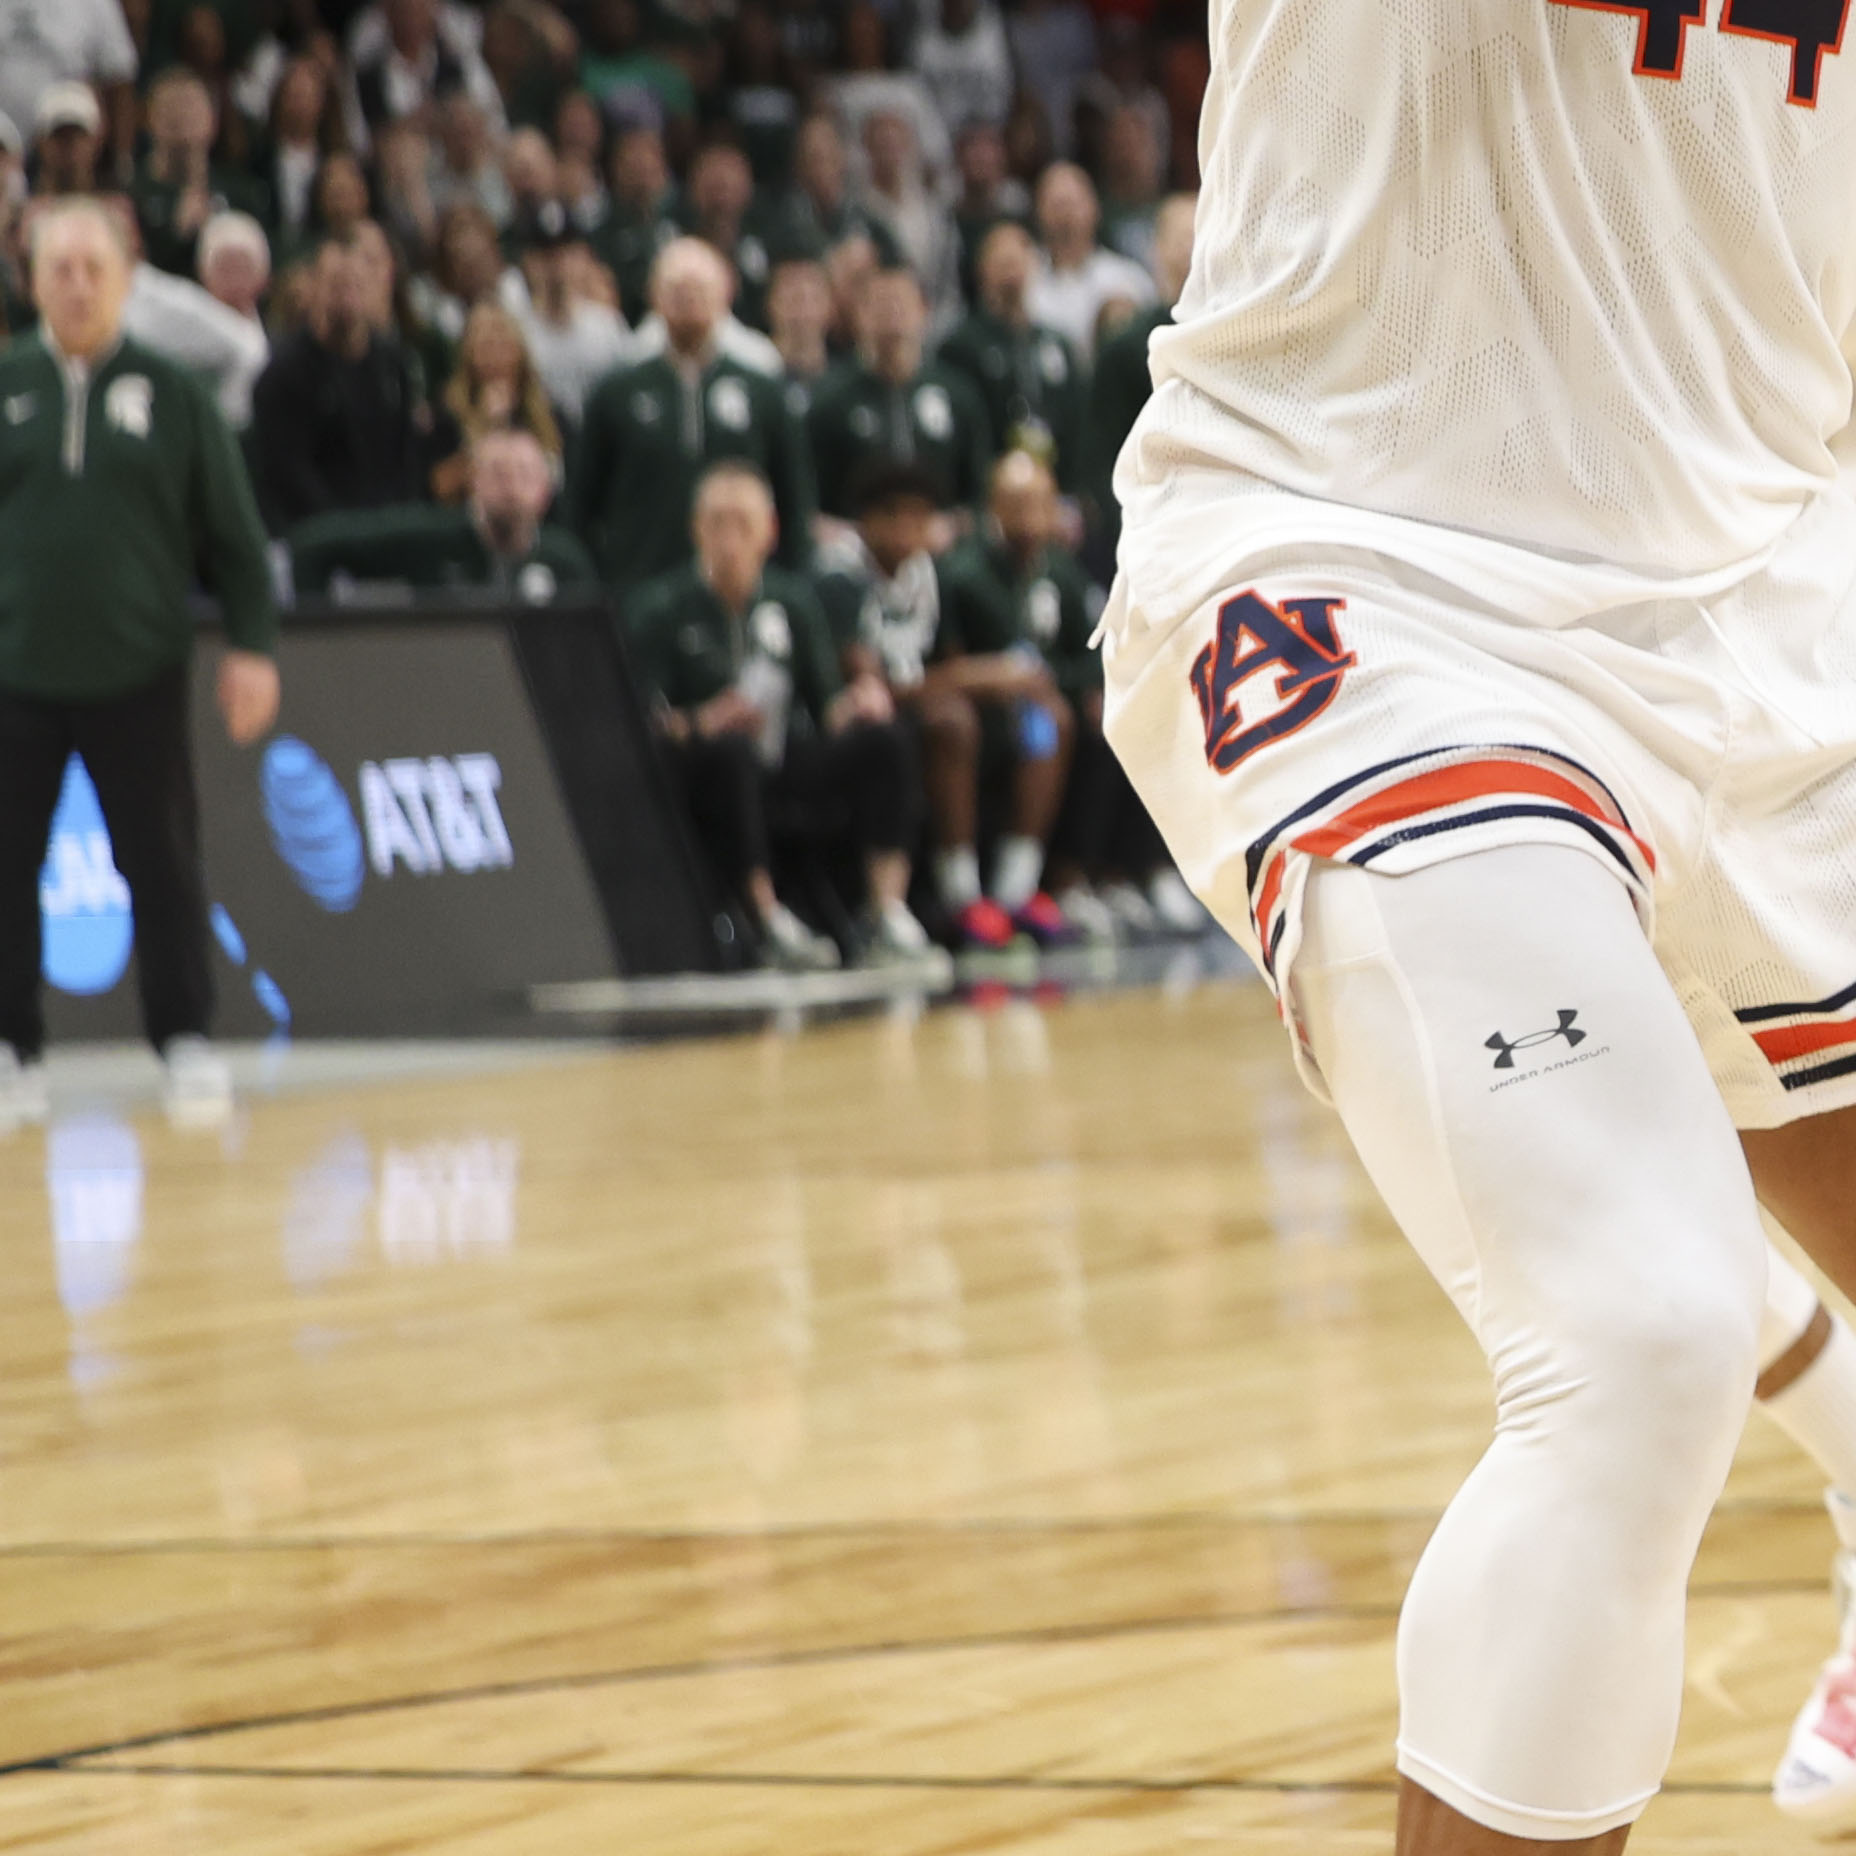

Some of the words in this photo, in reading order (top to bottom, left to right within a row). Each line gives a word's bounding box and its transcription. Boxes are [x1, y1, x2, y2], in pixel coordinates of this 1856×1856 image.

[359, 752, 514, 878] AT&T
[1489, 1070, 1538, 1093] UNDER
[1543, 1046, 1611, 1075] ARMOUR
